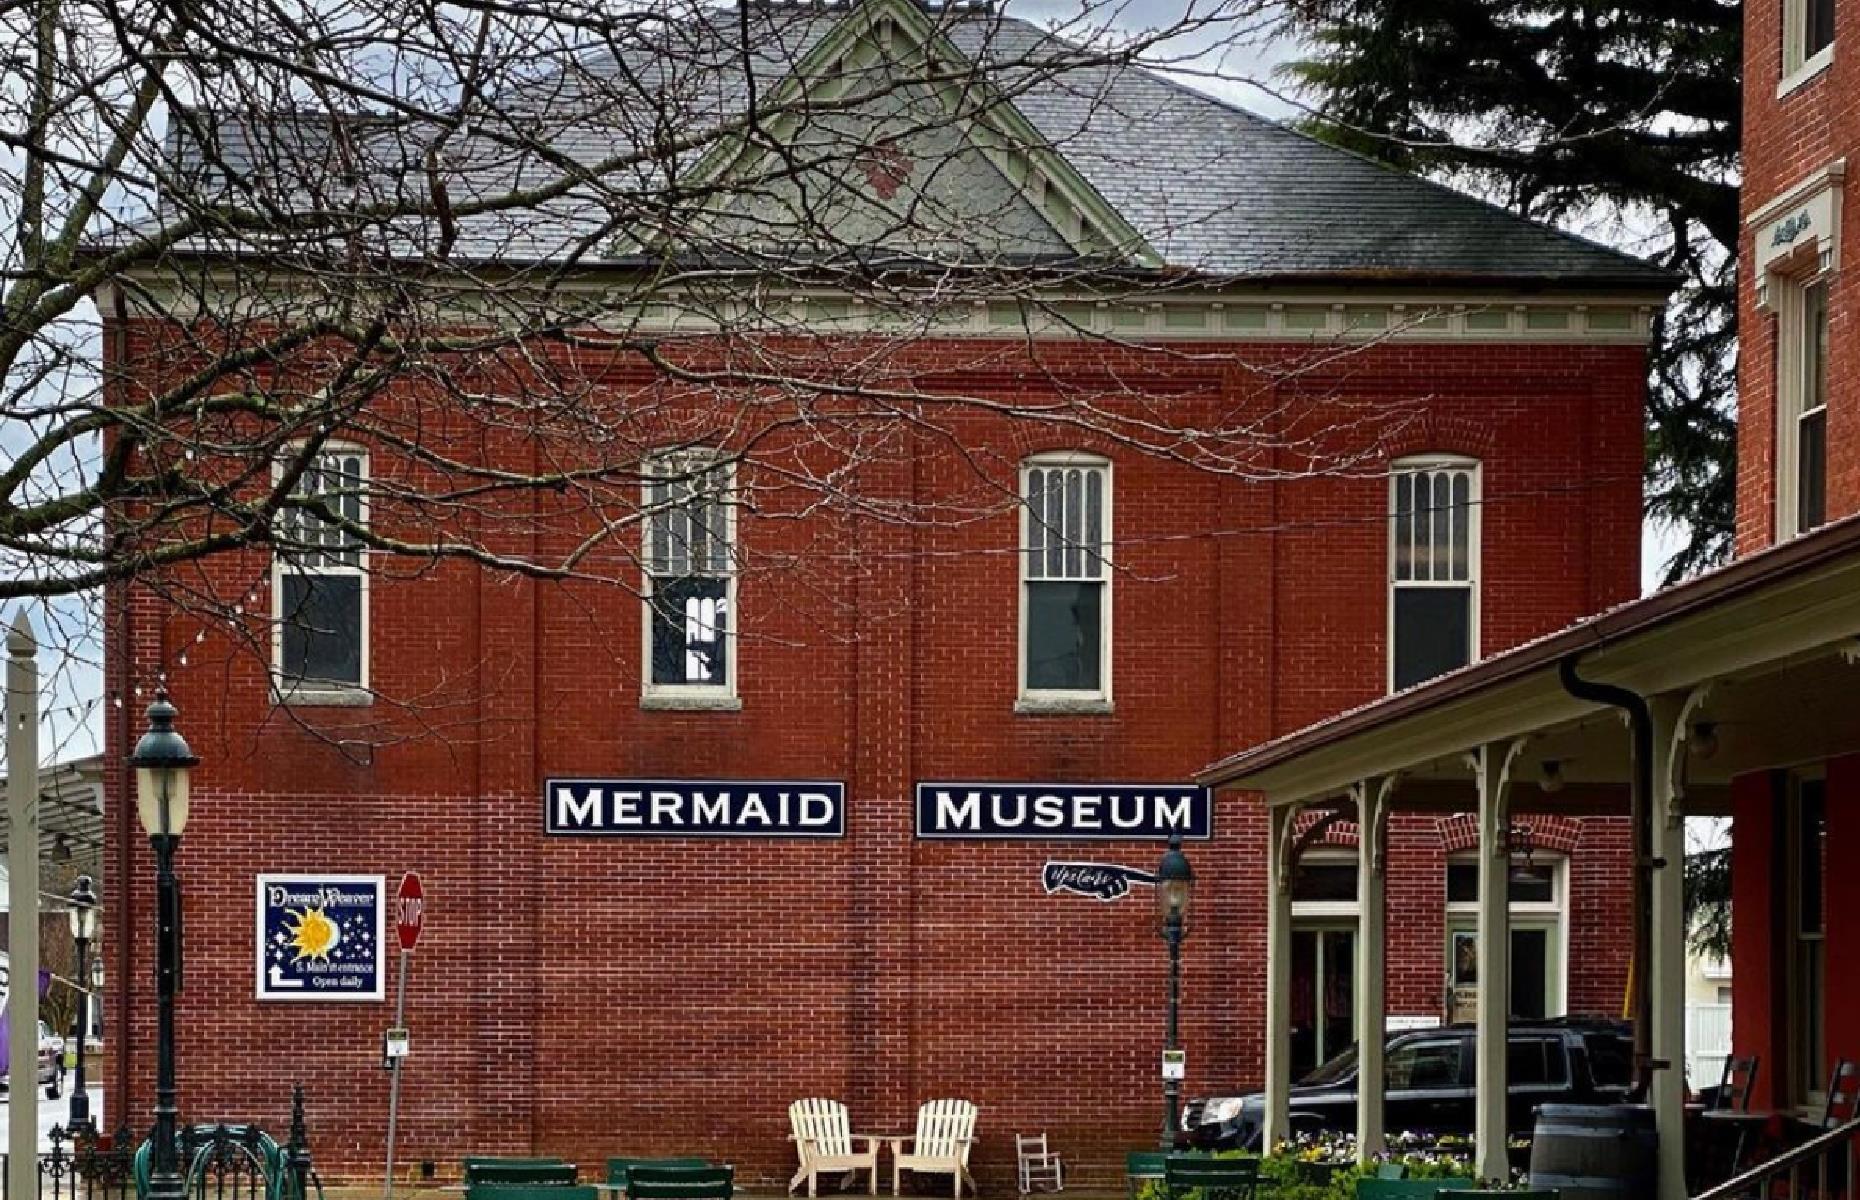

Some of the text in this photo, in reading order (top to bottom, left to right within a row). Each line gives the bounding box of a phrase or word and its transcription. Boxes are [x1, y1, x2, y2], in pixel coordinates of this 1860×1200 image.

[556, 787, 835, 827] MERMAID
[935, 791, 1192, 829] MUSEUM
[399, 897, 421, 927] STOP
[307, 962, 328, 974] Main
[312, 975, 363, 988] Open daily
